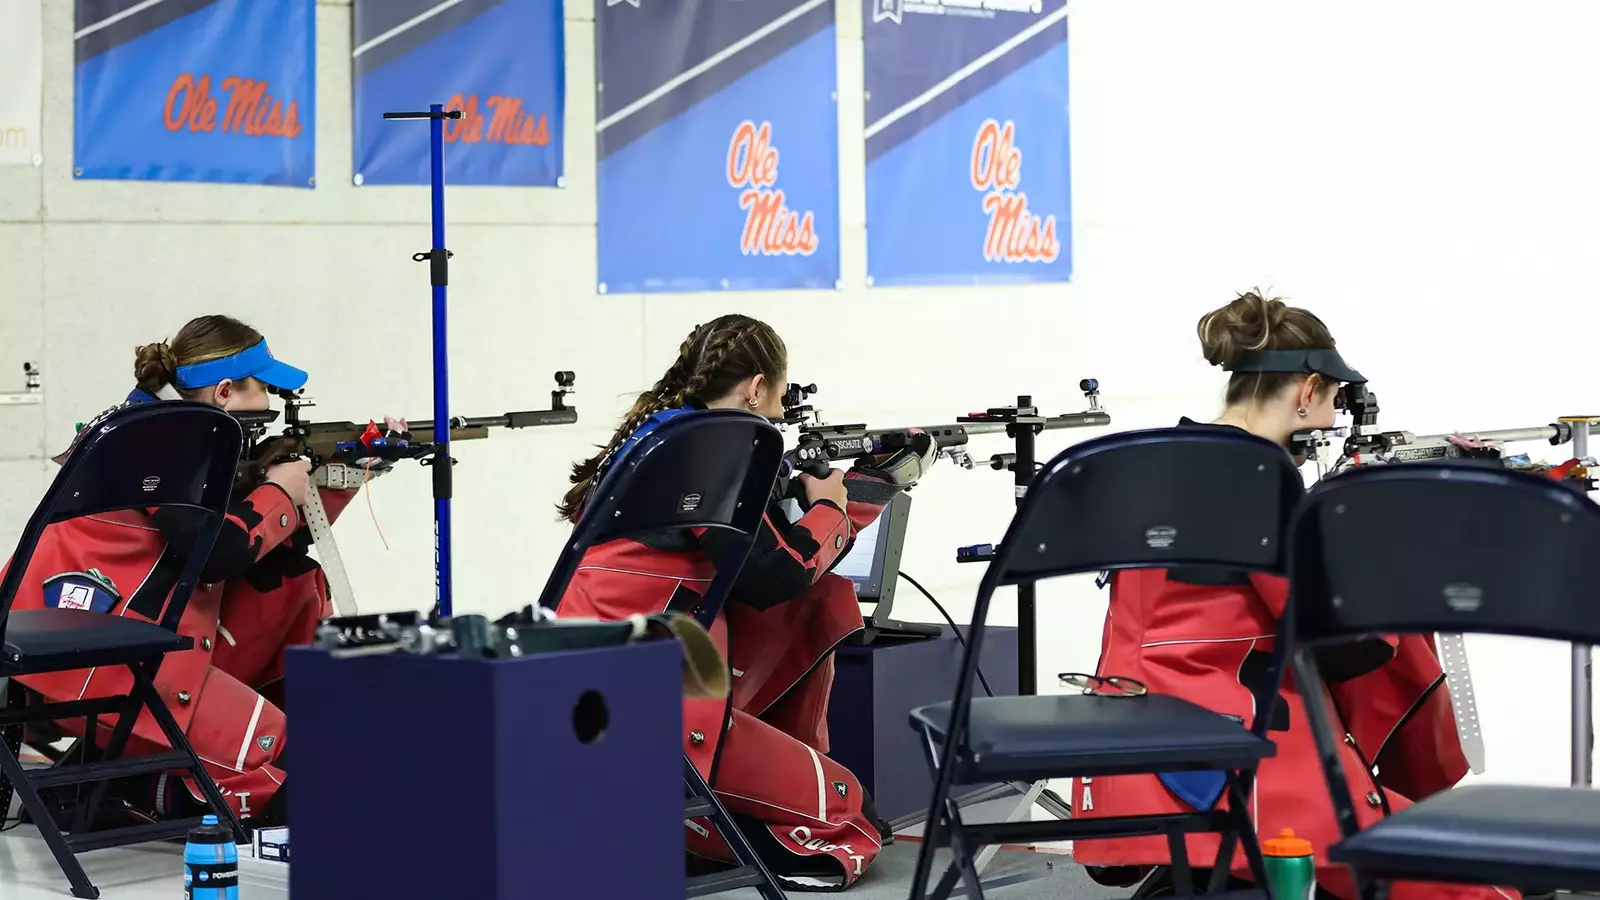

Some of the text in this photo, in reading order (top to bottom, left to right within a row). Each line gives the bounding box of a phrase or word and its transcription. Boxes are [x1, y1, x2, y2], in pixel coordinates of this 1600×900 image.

[163, 72, 302, 139] Ole Miss
[444, 92, 550, 146] Ole Miss
[727, 120, 779, 188] Ole
[971, 119, 1022, 191] Ole
[740, 188, 818, 256] Miss
[983, 192, 1060, 263] Miss
